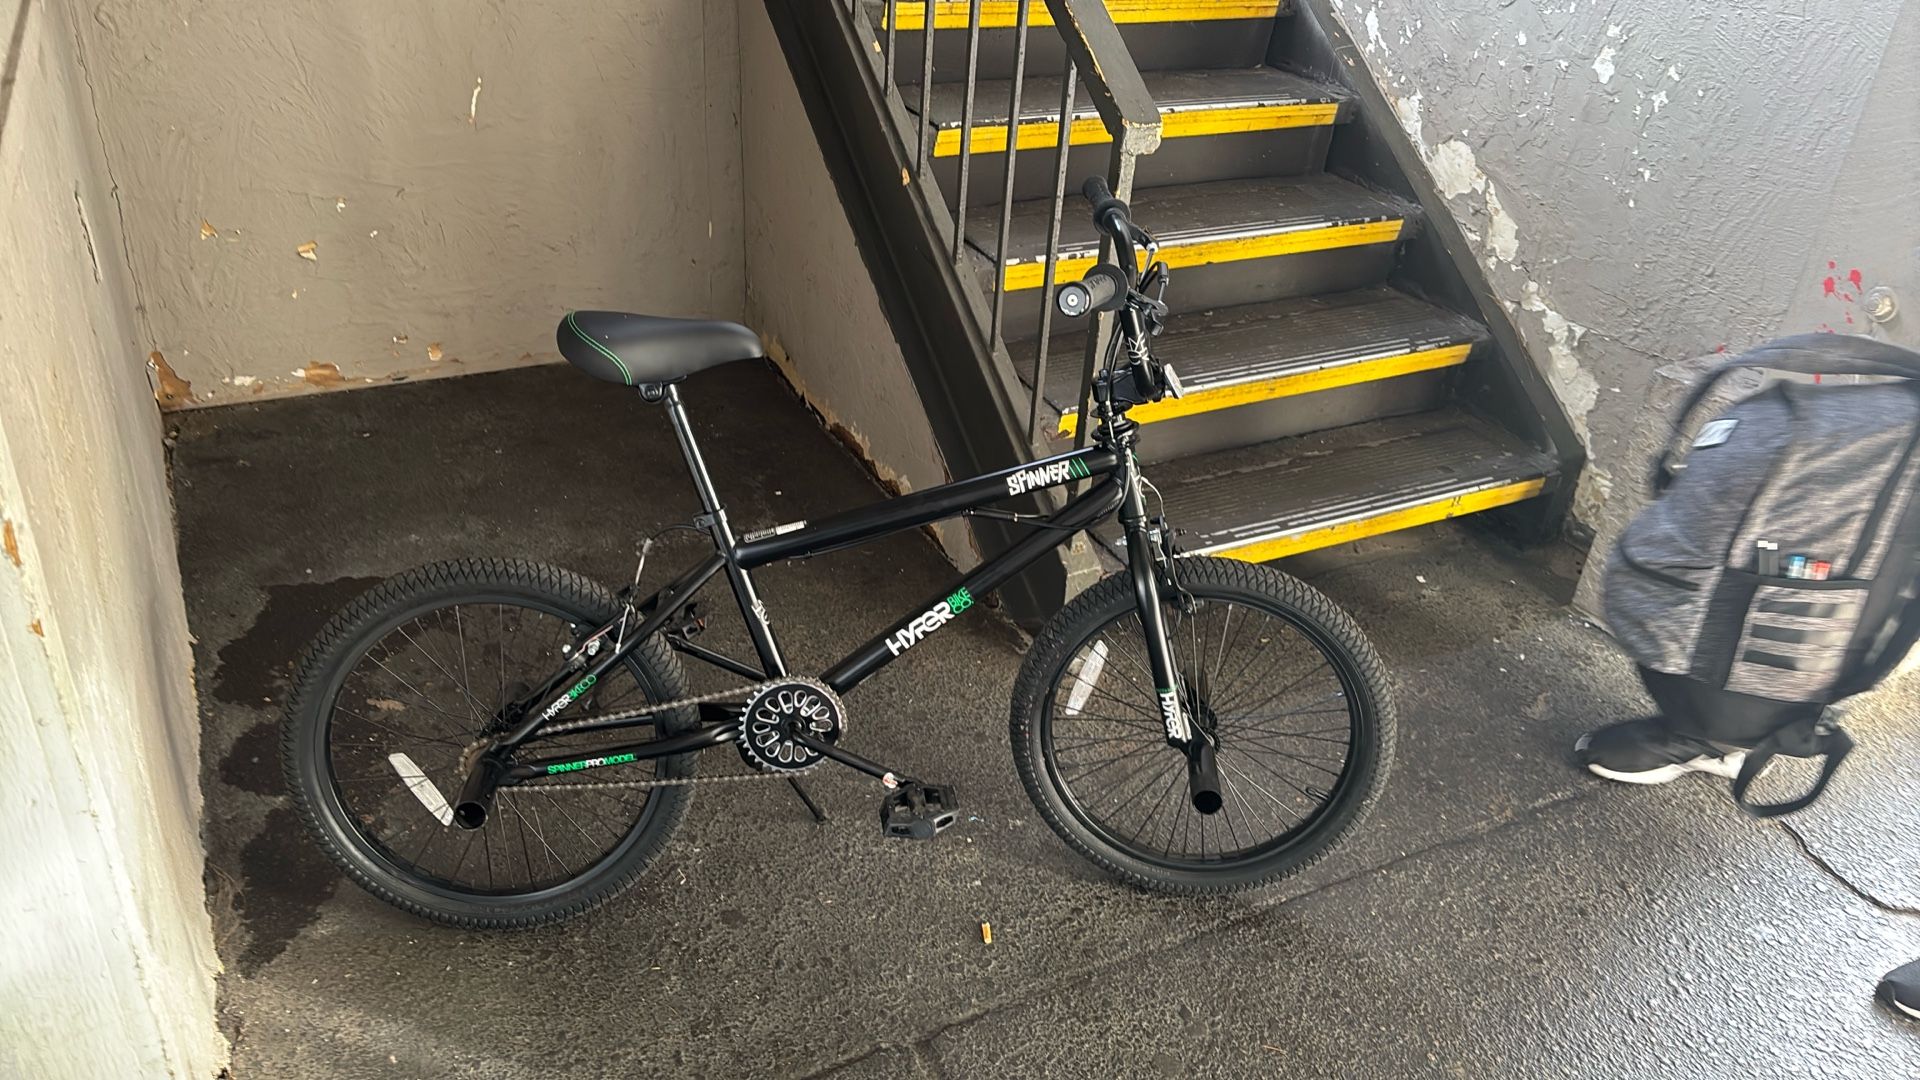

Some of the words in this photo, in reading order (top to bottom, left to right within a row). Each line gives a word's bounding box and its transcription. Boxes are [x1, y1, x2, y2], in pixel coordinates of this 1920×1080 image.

[1006, 460, 1070, 496] SPINNER
[946, 586, 971, 609] BIKE
[885, 601, 955, 656] HYPER
